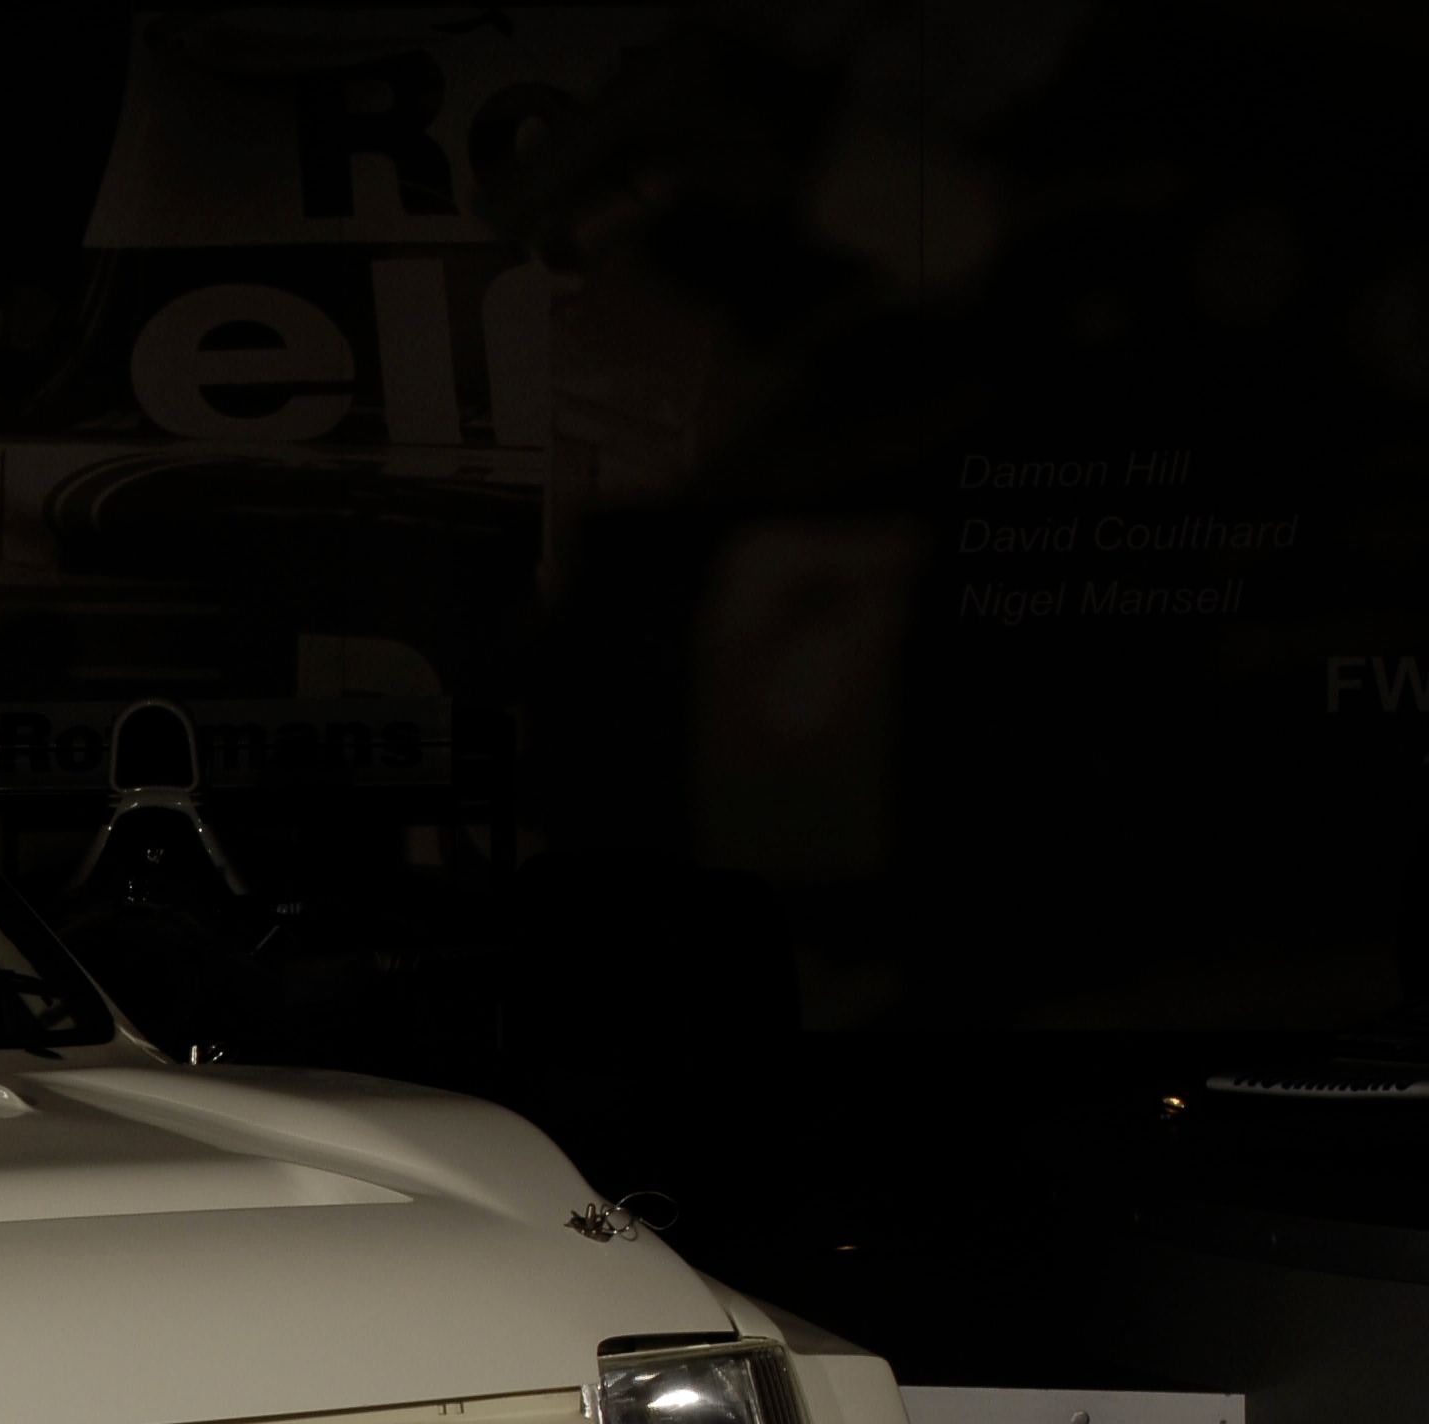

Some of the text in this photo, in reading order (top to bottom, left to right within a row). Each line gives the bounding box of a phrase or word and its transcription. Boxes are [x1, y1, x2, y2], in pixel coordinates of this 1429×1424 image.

[959, 449, 1193, 489] Damon Hill
[958, 513, 1299, 553] David Coulthard
[959, 578, 1245, 626] Nigel Mansell
